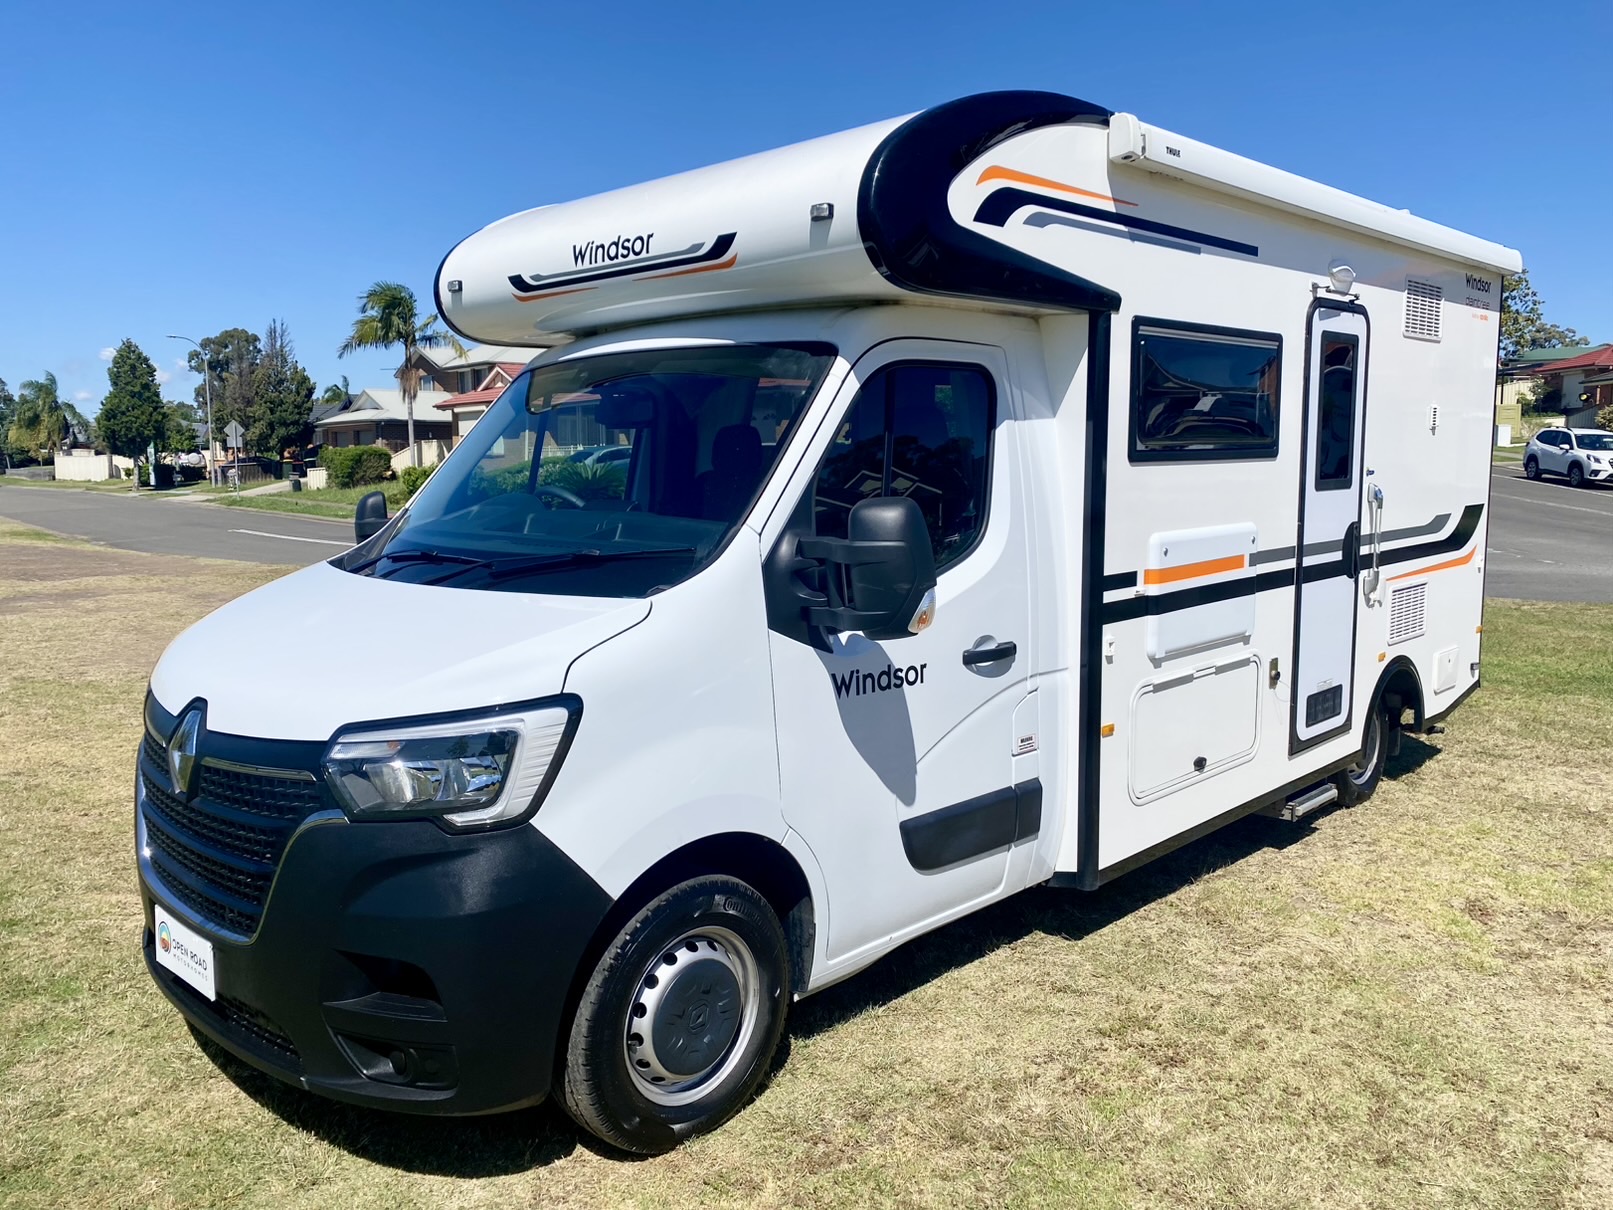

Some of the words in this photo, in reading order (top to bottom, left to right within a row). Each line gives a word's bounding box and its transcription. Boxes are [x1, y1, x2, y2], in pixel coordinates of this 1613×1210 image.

[1165, 145, 1181, 158] THULE
[573, 232, 654, 268] Windsor
[1465, 272, 1492, 293] Windsor
[831, 663, 927, 699] Windsor
[172, 938, 189, 957] OPEN
[189, 951, 208, 971] ROAD
